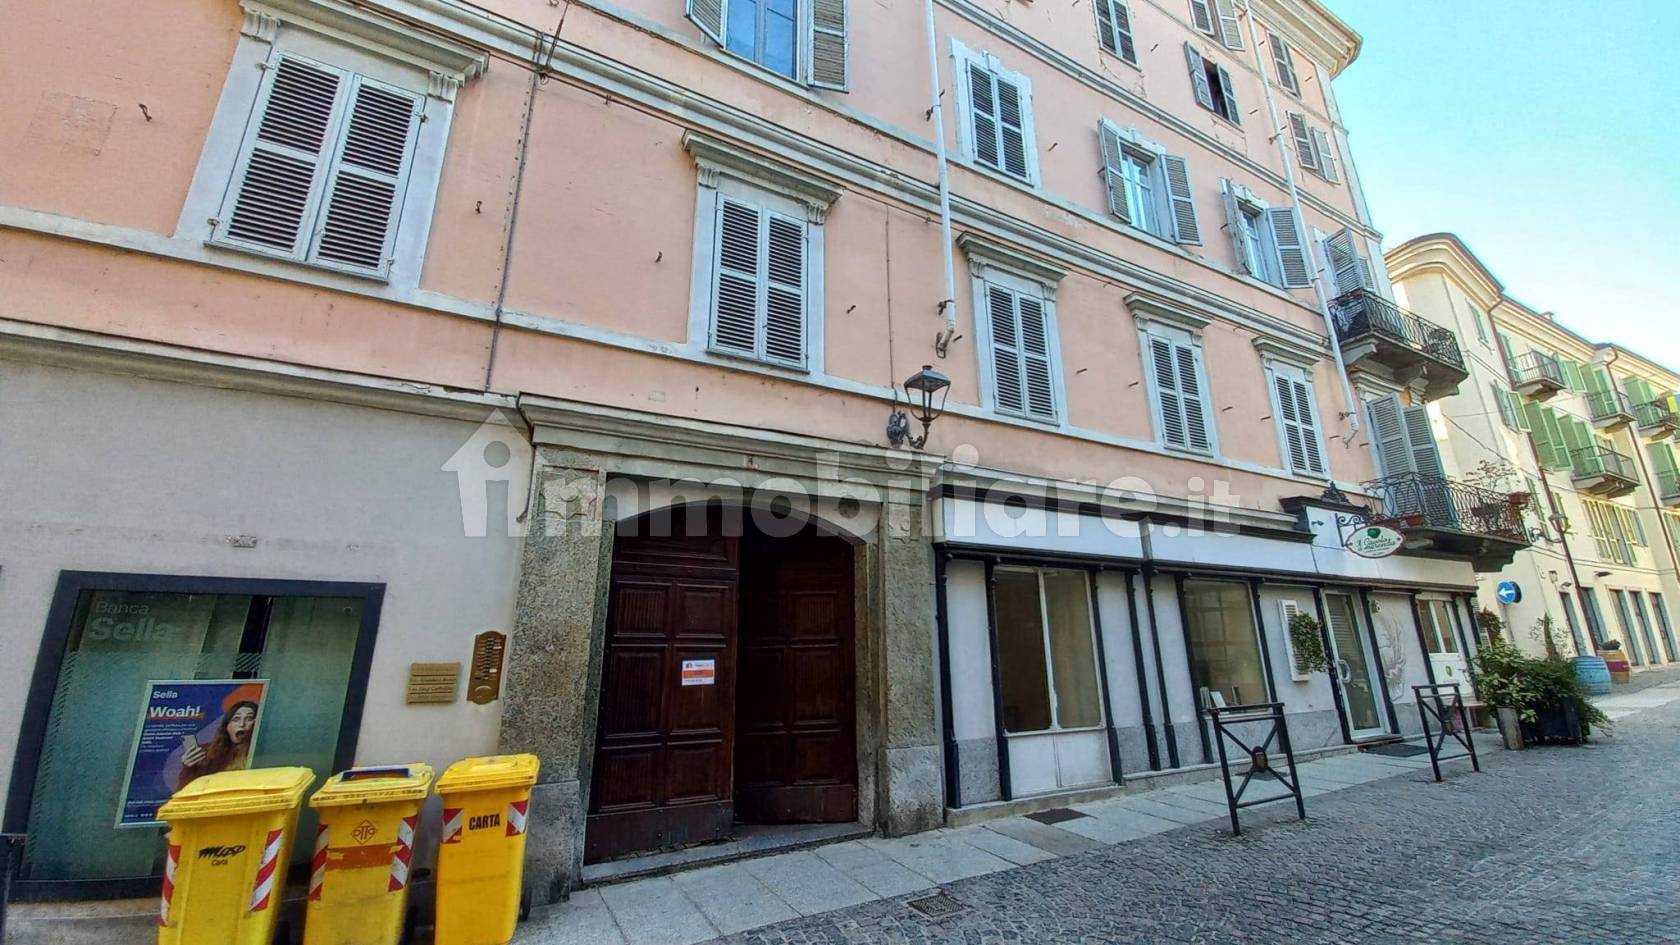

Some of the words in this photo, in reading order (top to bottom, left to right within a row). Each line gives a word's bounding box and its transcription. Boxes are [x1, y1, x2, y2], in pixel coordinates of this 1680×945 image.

[95, 600, 150, 614] Banca
[89, 617, 175, 641] Sella
[152, 690, 178, 699] Sella
[150, 704, 201, 718] Woah!
[468, 813, 501, 831] CARTA
